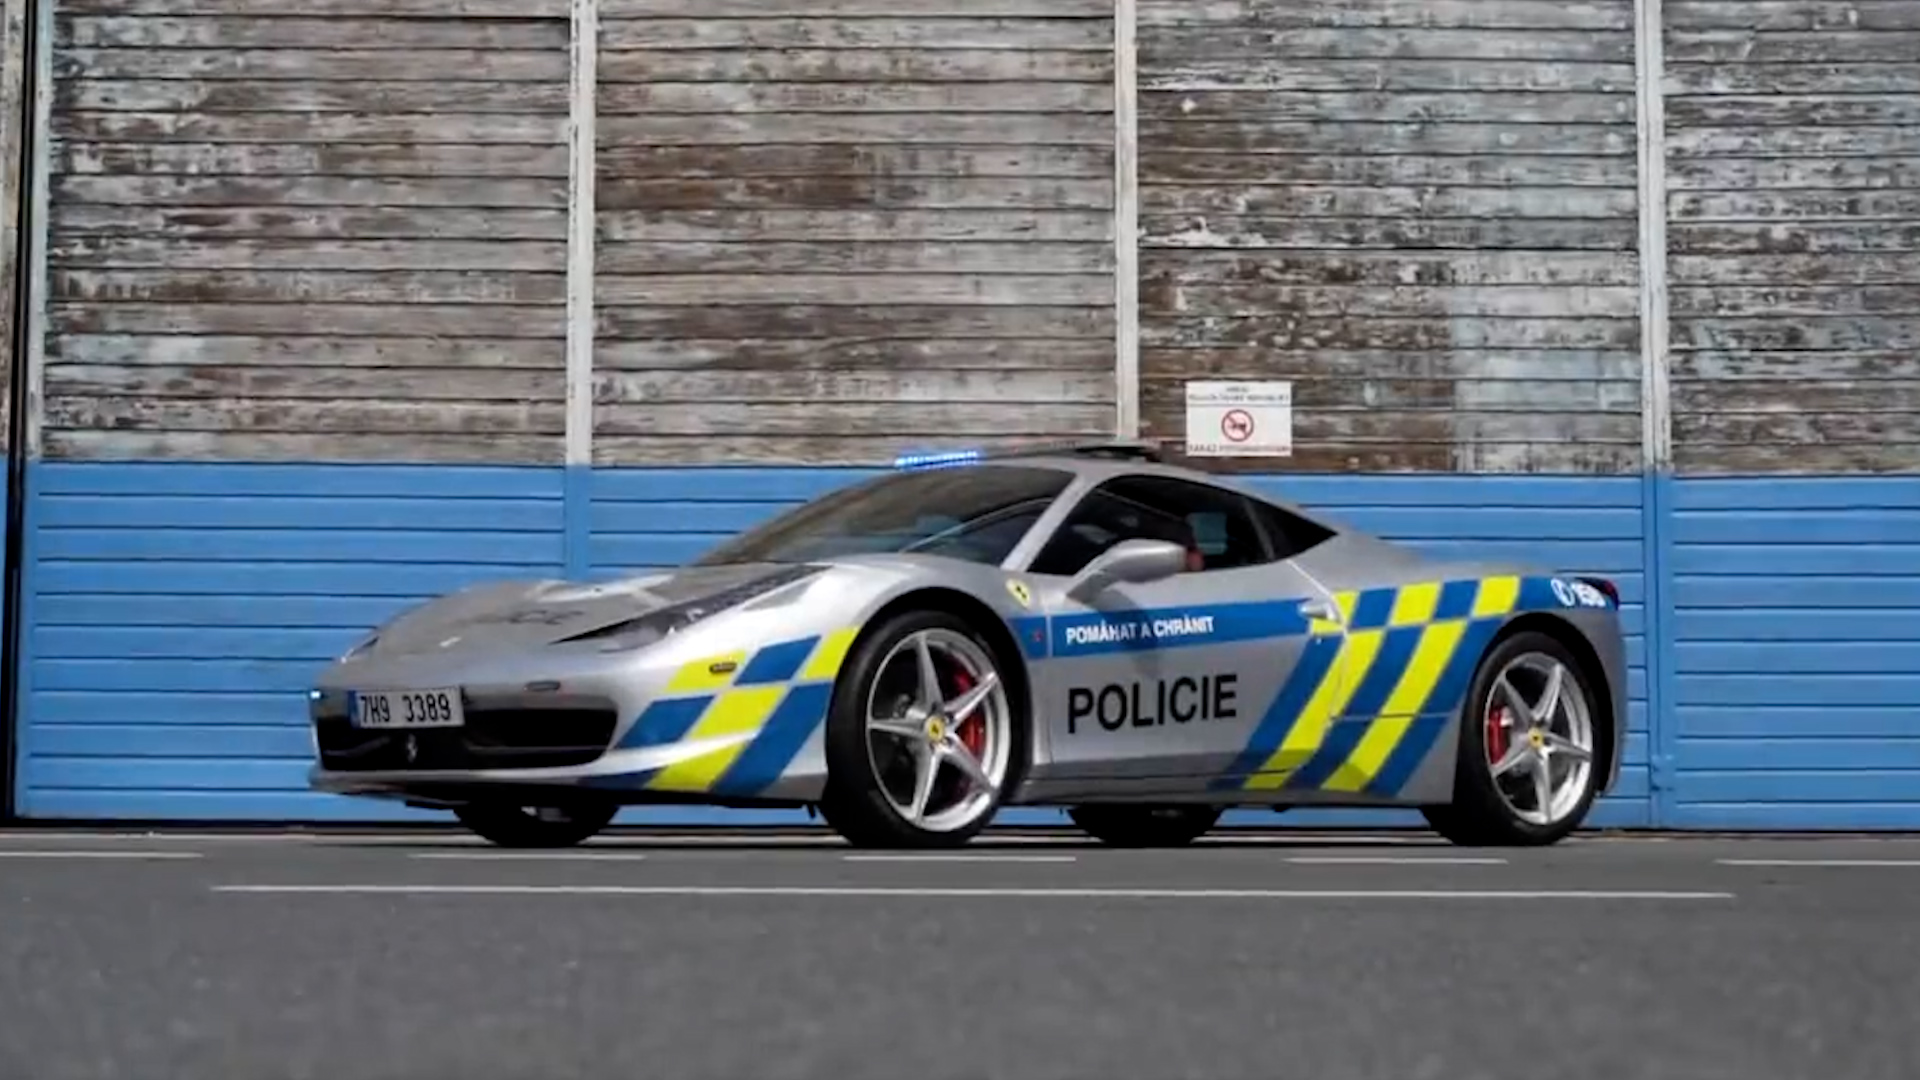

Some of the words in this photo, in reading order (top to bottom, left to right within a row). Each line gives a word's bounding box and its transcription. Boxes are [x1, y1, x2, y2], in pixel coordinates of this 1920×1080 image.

[1141, 623, 1151, 638] A
[360, 695, 391, 723] 7H9
[402, 693, 451, 722] 3389
[1068, 674, 1237, 734] POLICIE
